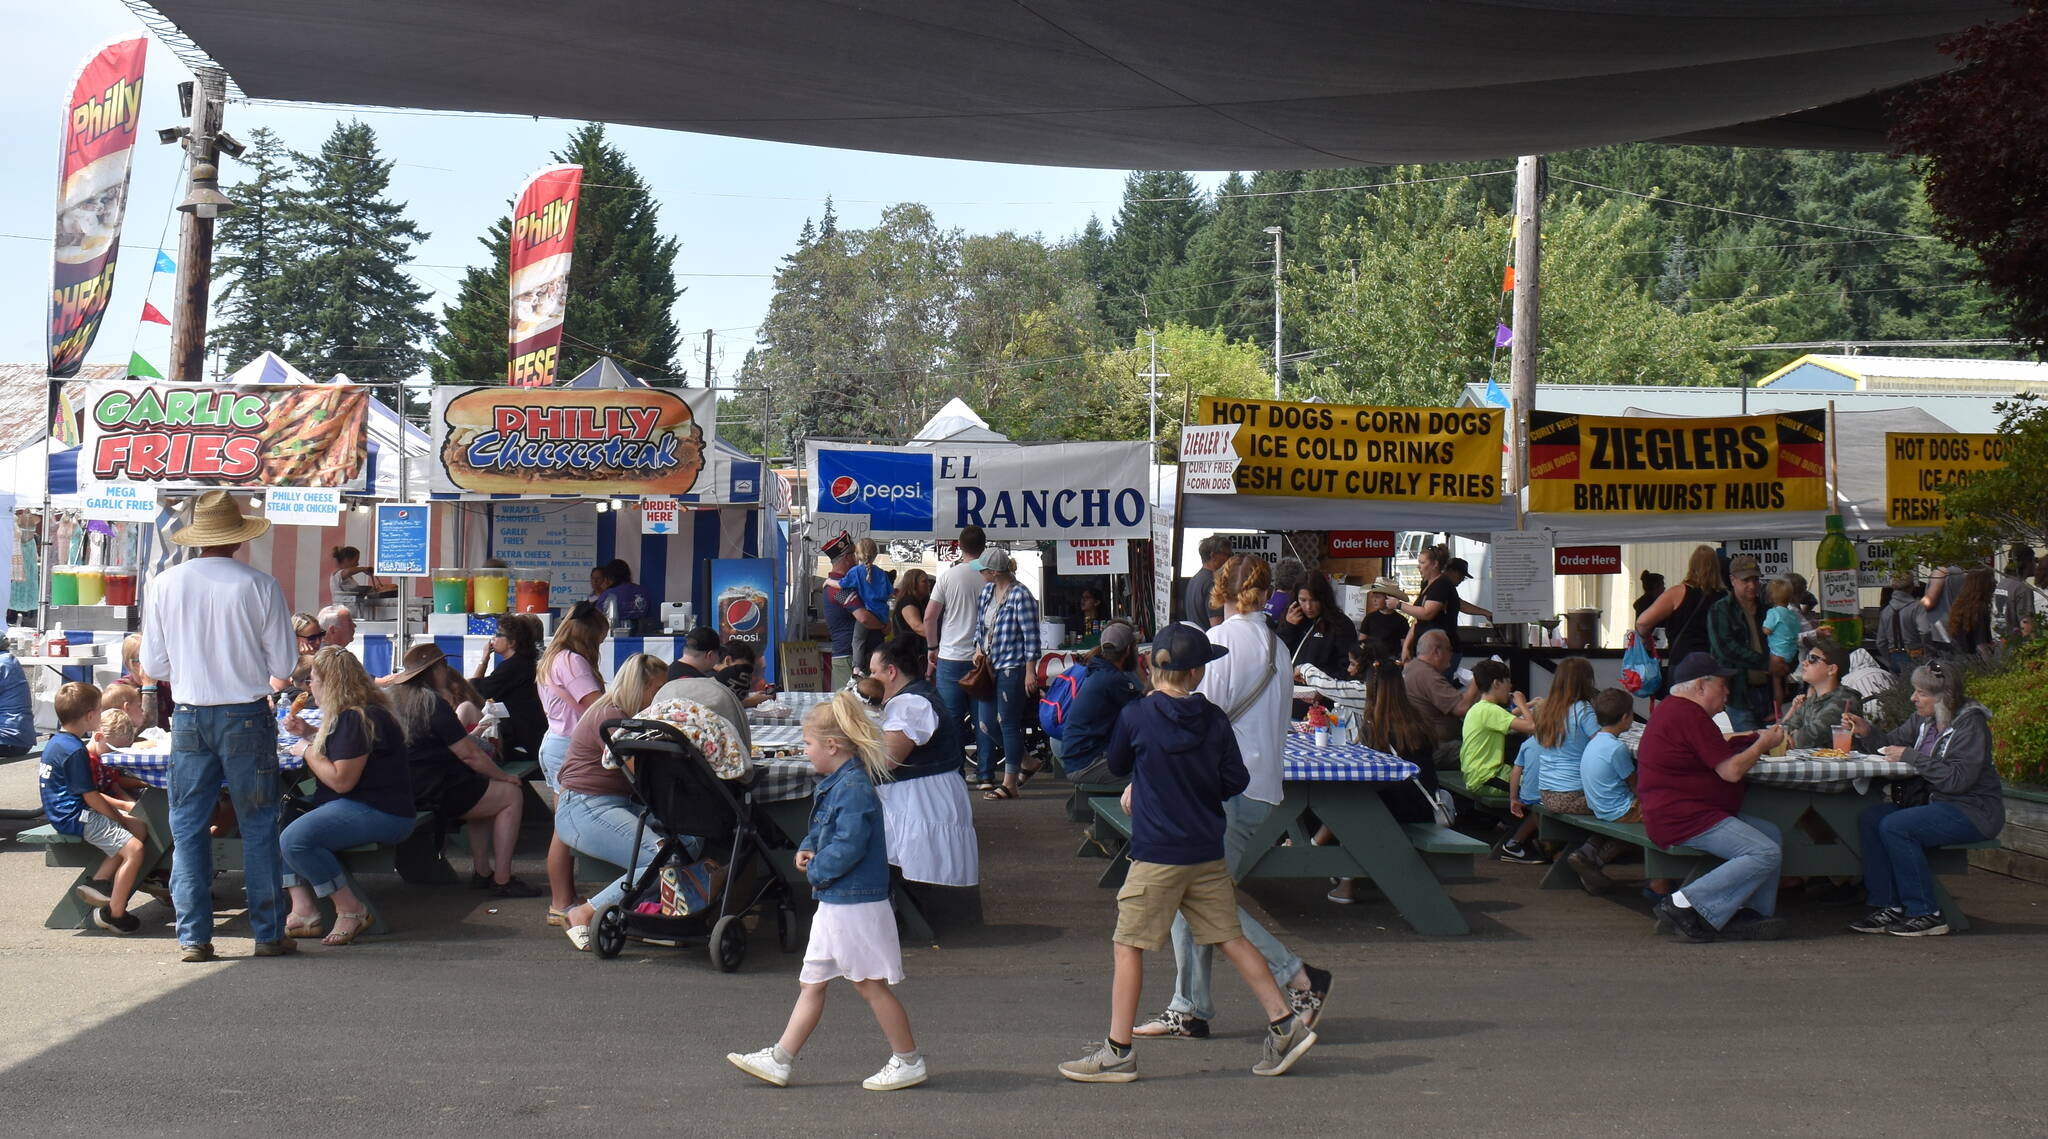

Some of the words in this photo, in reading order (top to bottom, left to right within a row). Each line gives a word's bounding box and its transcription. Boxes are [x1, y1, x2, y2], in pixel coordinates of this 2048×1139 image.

[73, 77, 143, 147] Philly
[514, 197, 574, 253] Philly
[94, 388, 267, 430] GARLIC
[1212, 402, 1260, 427] HOT
[1269, 405, 1334, 430] DOGS
[1355, 410, 1420, 434] CORN
[1428, 411, 1492, 435] DOGS
[494, 407, 661, 441] PHILLY
[94, 431, 262, 478] FRIES
[467, 431, 679, 470] Cheesesteak
[1184, 431, 1230, 456] ZIEGLER'S
[1250, 433, 1288, 459] ICE
[1296, 436, 1358, 461] COLD
[1367, 439, 1454, 464] DRINKS
[1588, 425, 1769, 471] ZIEGLERS
[1894, 438, 1924, 460] HOT
[1929, 438, 1969, 461] DOGS
[939, 455, 978, 479] EL
[1188, 462, 1211, 473] CURLY
[1213, 461, 1233, 473] FRIES
[1212, 478, 1231, 490] DOGS
[1237, 465, 1282, 490] ESH
[1290, 467, 1338, 494] CUT
[1345, 470, 1422, 496] CURLY
[1429, 473, 1495, 498] FRIES
[1918, 469, 1942, 491] ICE
[106, 487, 136, 498] MEGA
[272, 491, 301, 501] PHILLY
[303, 492, 334, 503] CHEESE
[863, 481, 921, 502] pepsi
[1573, 483, 1717, 511] BRATWURST
[1725, 482, 1785, 509] HAUS
[86, 498, 123, 510] GARLIC
[126, 499, 154, 511] FRIES
[267, 502, 291, 511] STEAK
[293, 503, 304, 512] OR
[306, 504, 338, 514] CHICKEN
[642, 500, 677, 511] ORDER
[954, 486, 1146, 529] RANCHO
[1892, 498, 1939, 521] FRESH
[646, 511, 673, 522] HERE
[1228, 535, 1270, 550] GIANT
[1333, 538, 1363, 549] Order
[1364, 538, 1390, 548] Here
[1739, 538, 1779, 550] GIANT
[496, 551, 522, 559] EXTRA
[524, 551, 552, 559] CHEESE
[1076, 550, 1110, 566] HERE
[1560, 555, 1590, 565] Order
[1591, 554, 1617, 565] Here
[1765, 552, 1788, 563] DOG
